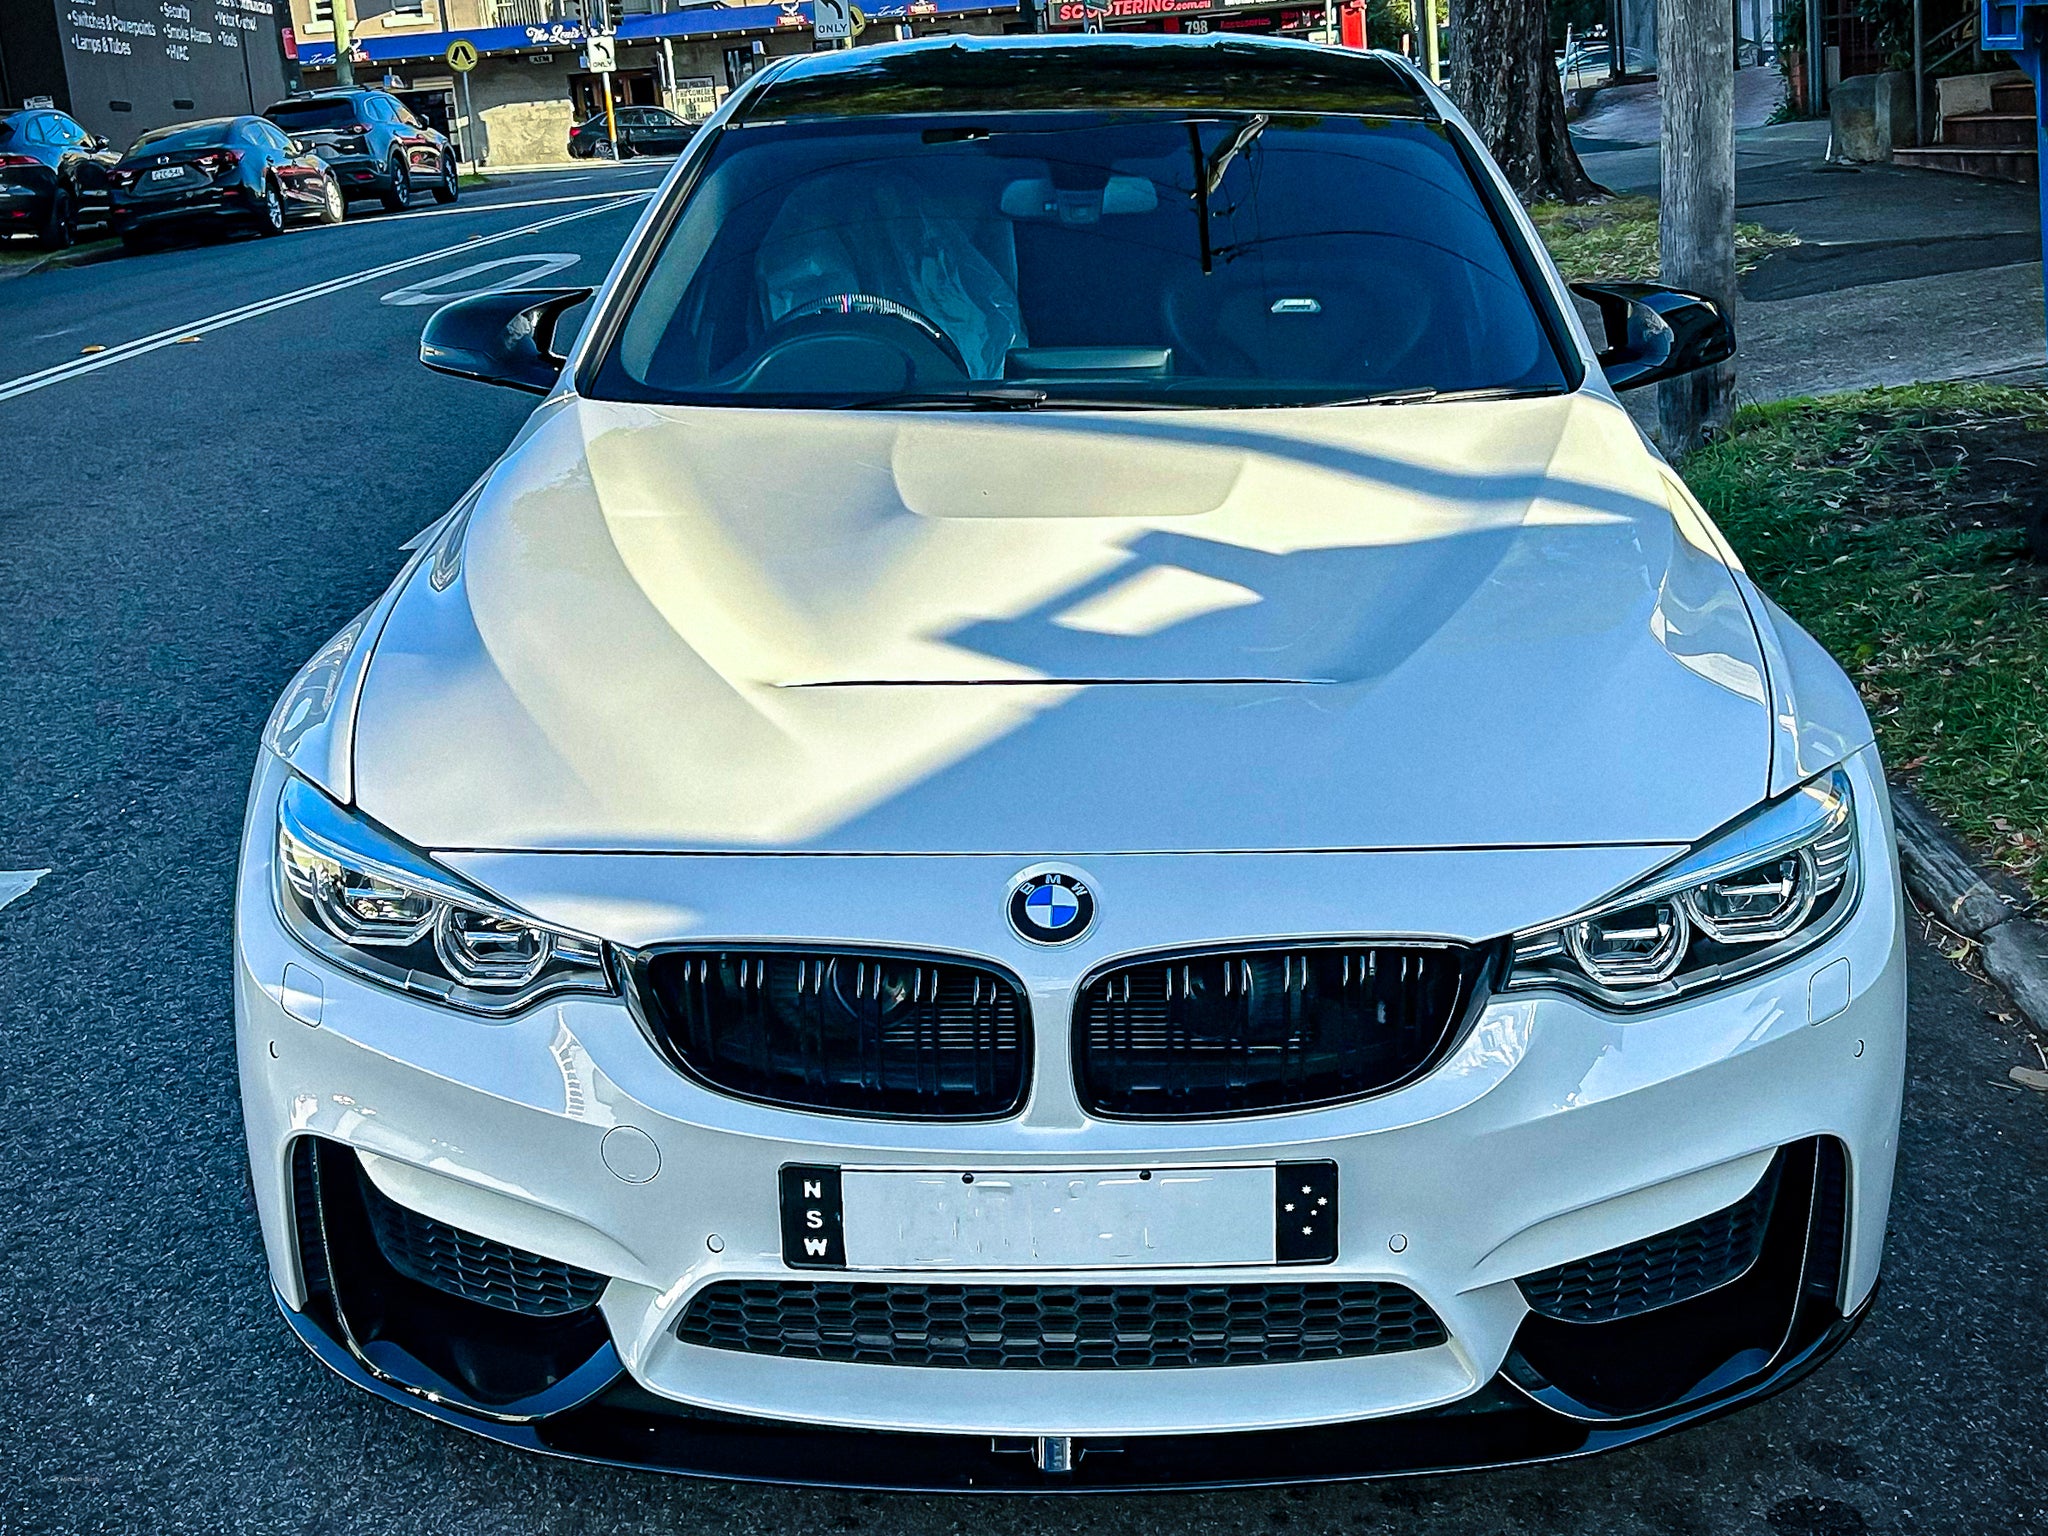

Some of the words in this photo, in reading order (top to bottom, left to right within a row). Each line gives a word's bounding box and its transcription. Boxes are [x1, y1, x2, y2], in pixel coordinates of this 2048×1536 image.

[163, 2, 190, 23] Security
[112, 15, 156, 37] Powerpoints
[818, 23, 848, 34] ONLY
[1185, 20, 1208, 34] 798
[74, 33, 101, 55] Lamps
[592, 60, 613, 68] ONLY
[1019, 874, 1088, 896] BMW
